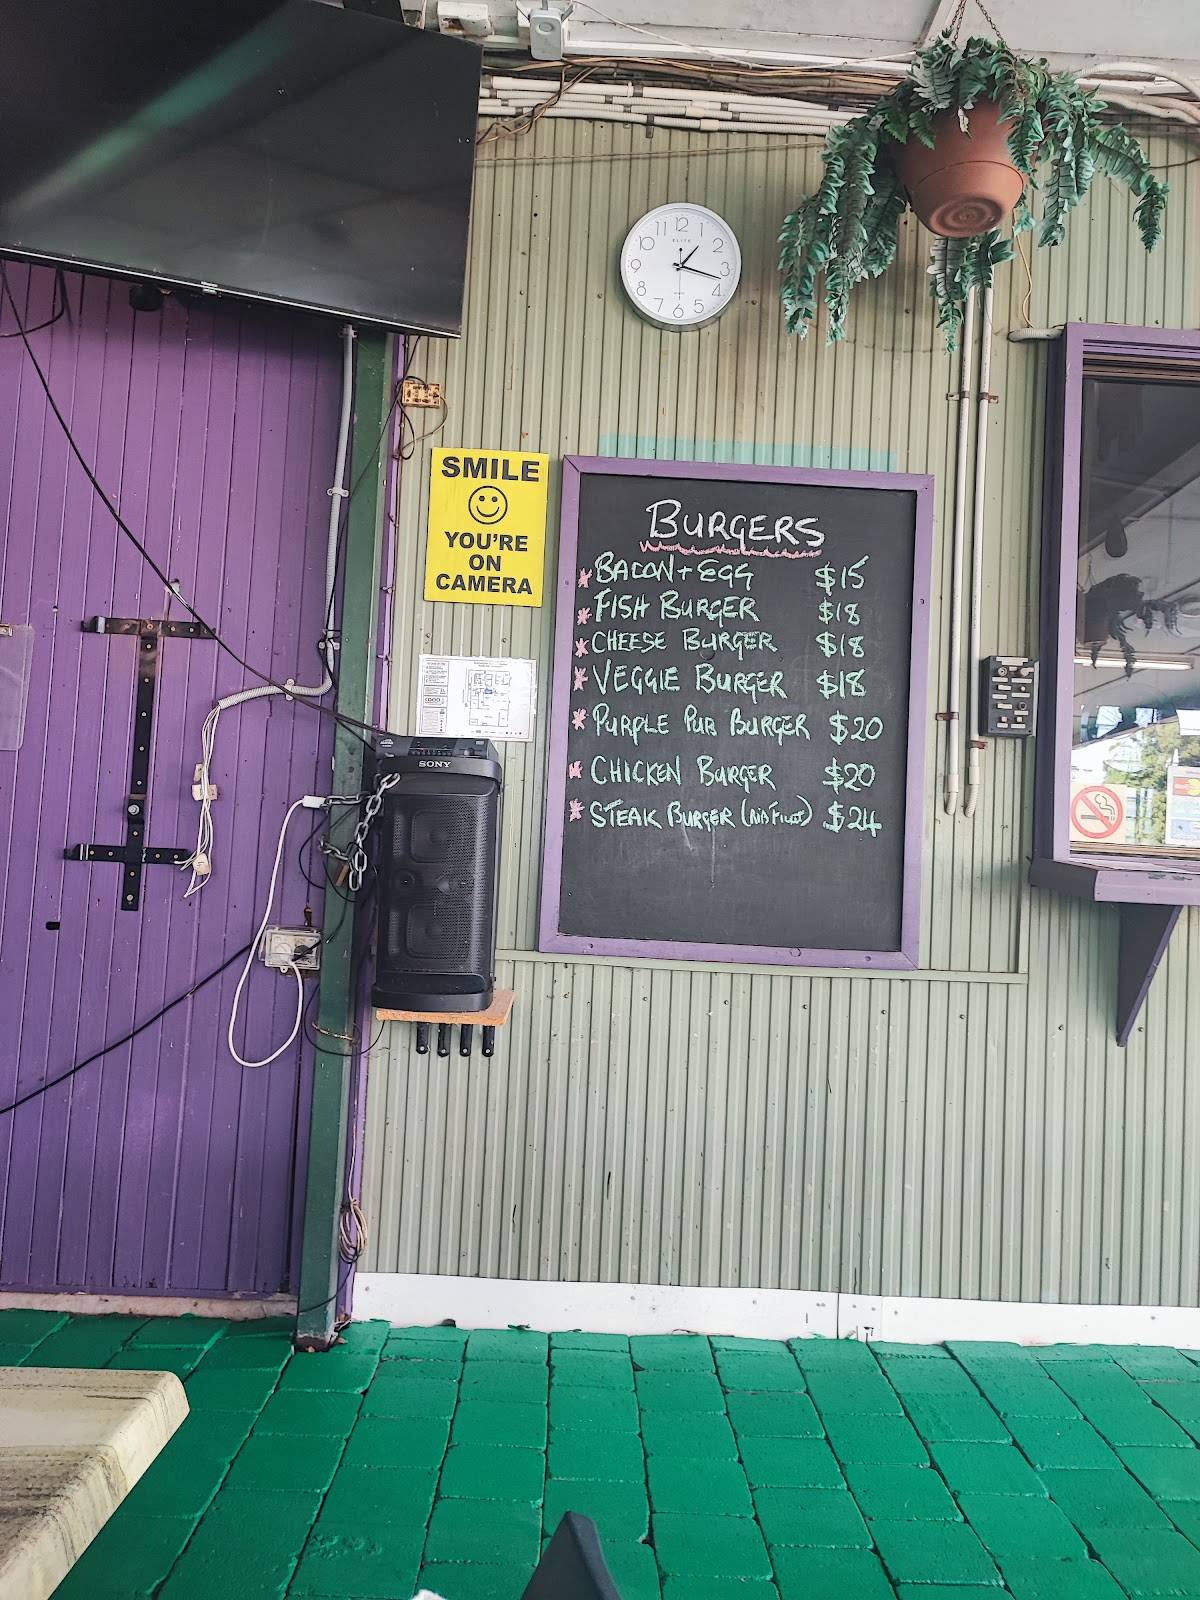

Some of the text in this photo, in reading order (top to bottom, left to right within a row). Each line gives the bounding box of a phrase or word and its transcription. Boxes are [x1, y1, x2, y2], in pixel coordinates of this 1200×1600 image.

[656, 221, 667, 236] 11
[675, 217, 689, 232] 12
[639, 236, 655, 251] 10
[712, 237, 724, 253] 2
[630, 259, 641, 273] 9
[720, 261, 731, 276] 3
[636, 281, 646, 296] 8
[711, 283, 726, 297] 4
[653, 297, 664, 312] 7
[673, 303, 684, 318] 6
[694, 299, 704, 313] 5
[441, 456, 540, 482] SMILE
[645, 499, 825, 551] BURGERS
[444, 531, 528, 551] YOU'RE
[469, 554, 501, 571] ON
[436, 573, 533, 594] CAMERA
[815, 555, 869, 596] $15
[593, 588, 860, 628] FISH BURGER $18
[591, 627, 865, 661] CHEESE BURGER $18
[593, 659, 867, 704] VEGGIE BURGER $18
[592, 702, 883, 746] PURPLE PUB BURGER $20
[418, 760, 452, 768] SONY
[590, 754, 875, 794] CHICKEN BURGER $20
[589, 798, 662, 829] STEAK
[667, 800, 736, 832] BURGER
[822, 800, 883, 838] $24
